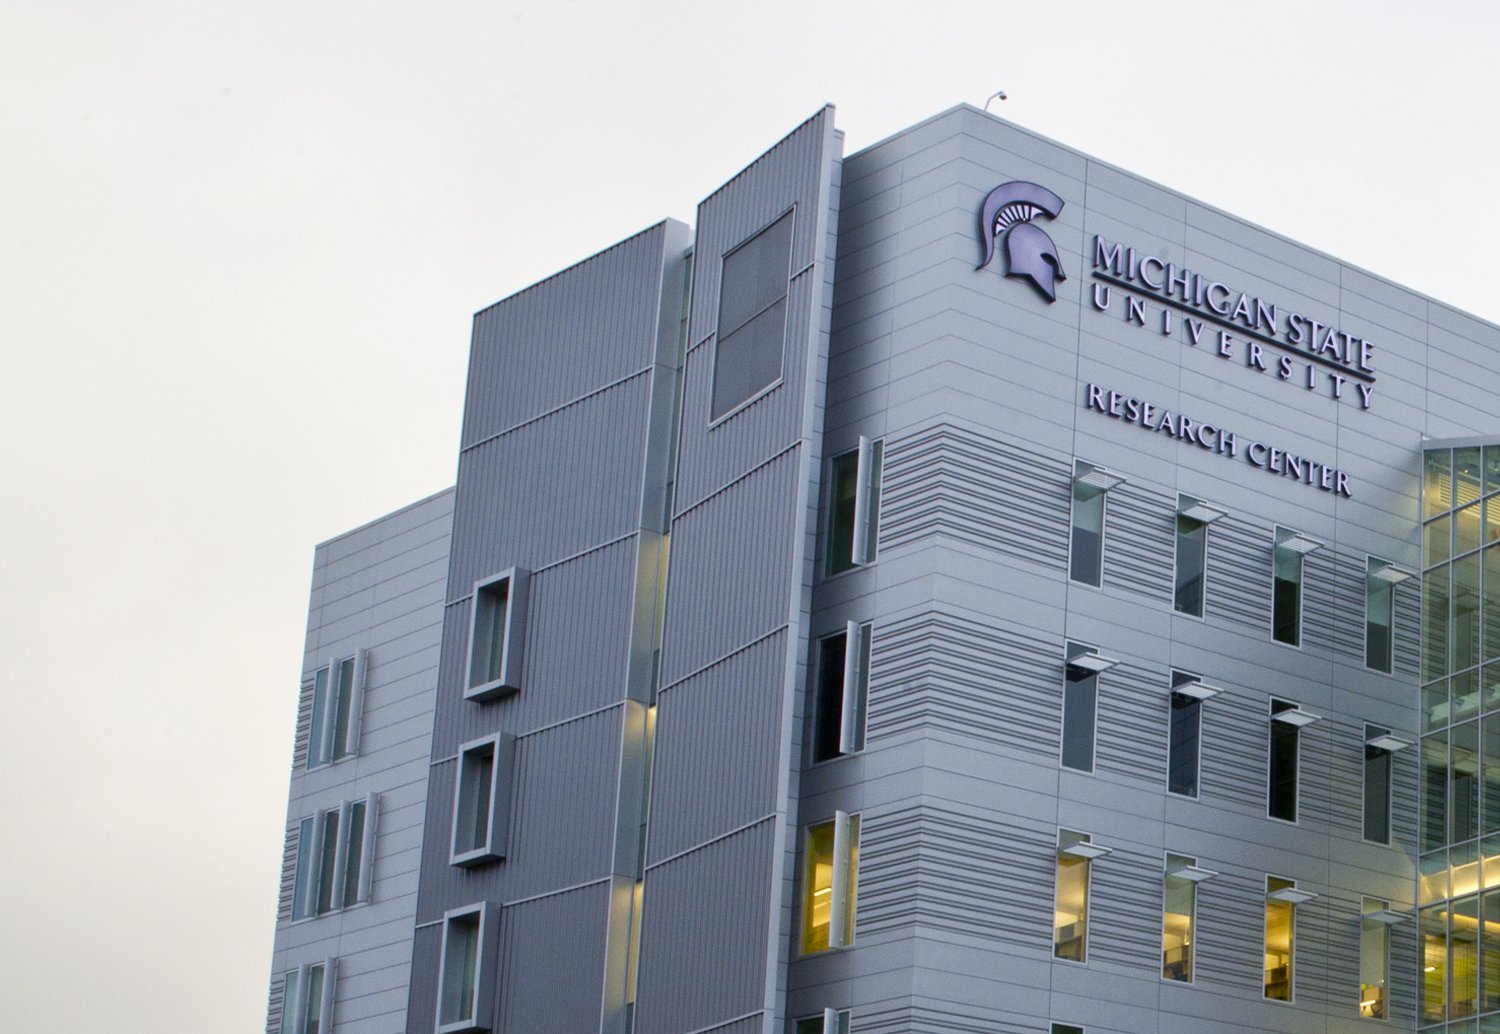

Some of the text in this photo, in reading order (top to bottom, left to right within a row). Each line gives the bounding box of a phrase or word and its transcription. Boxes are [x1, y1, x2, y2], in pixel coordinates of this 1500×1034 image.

[1091, 282, 1374, 409] UNIVERSITY
[1092, 234, 1376, 372] MICHIGAN STATE
[1087, 383, 1352, 497] RESEARCH CENTER
